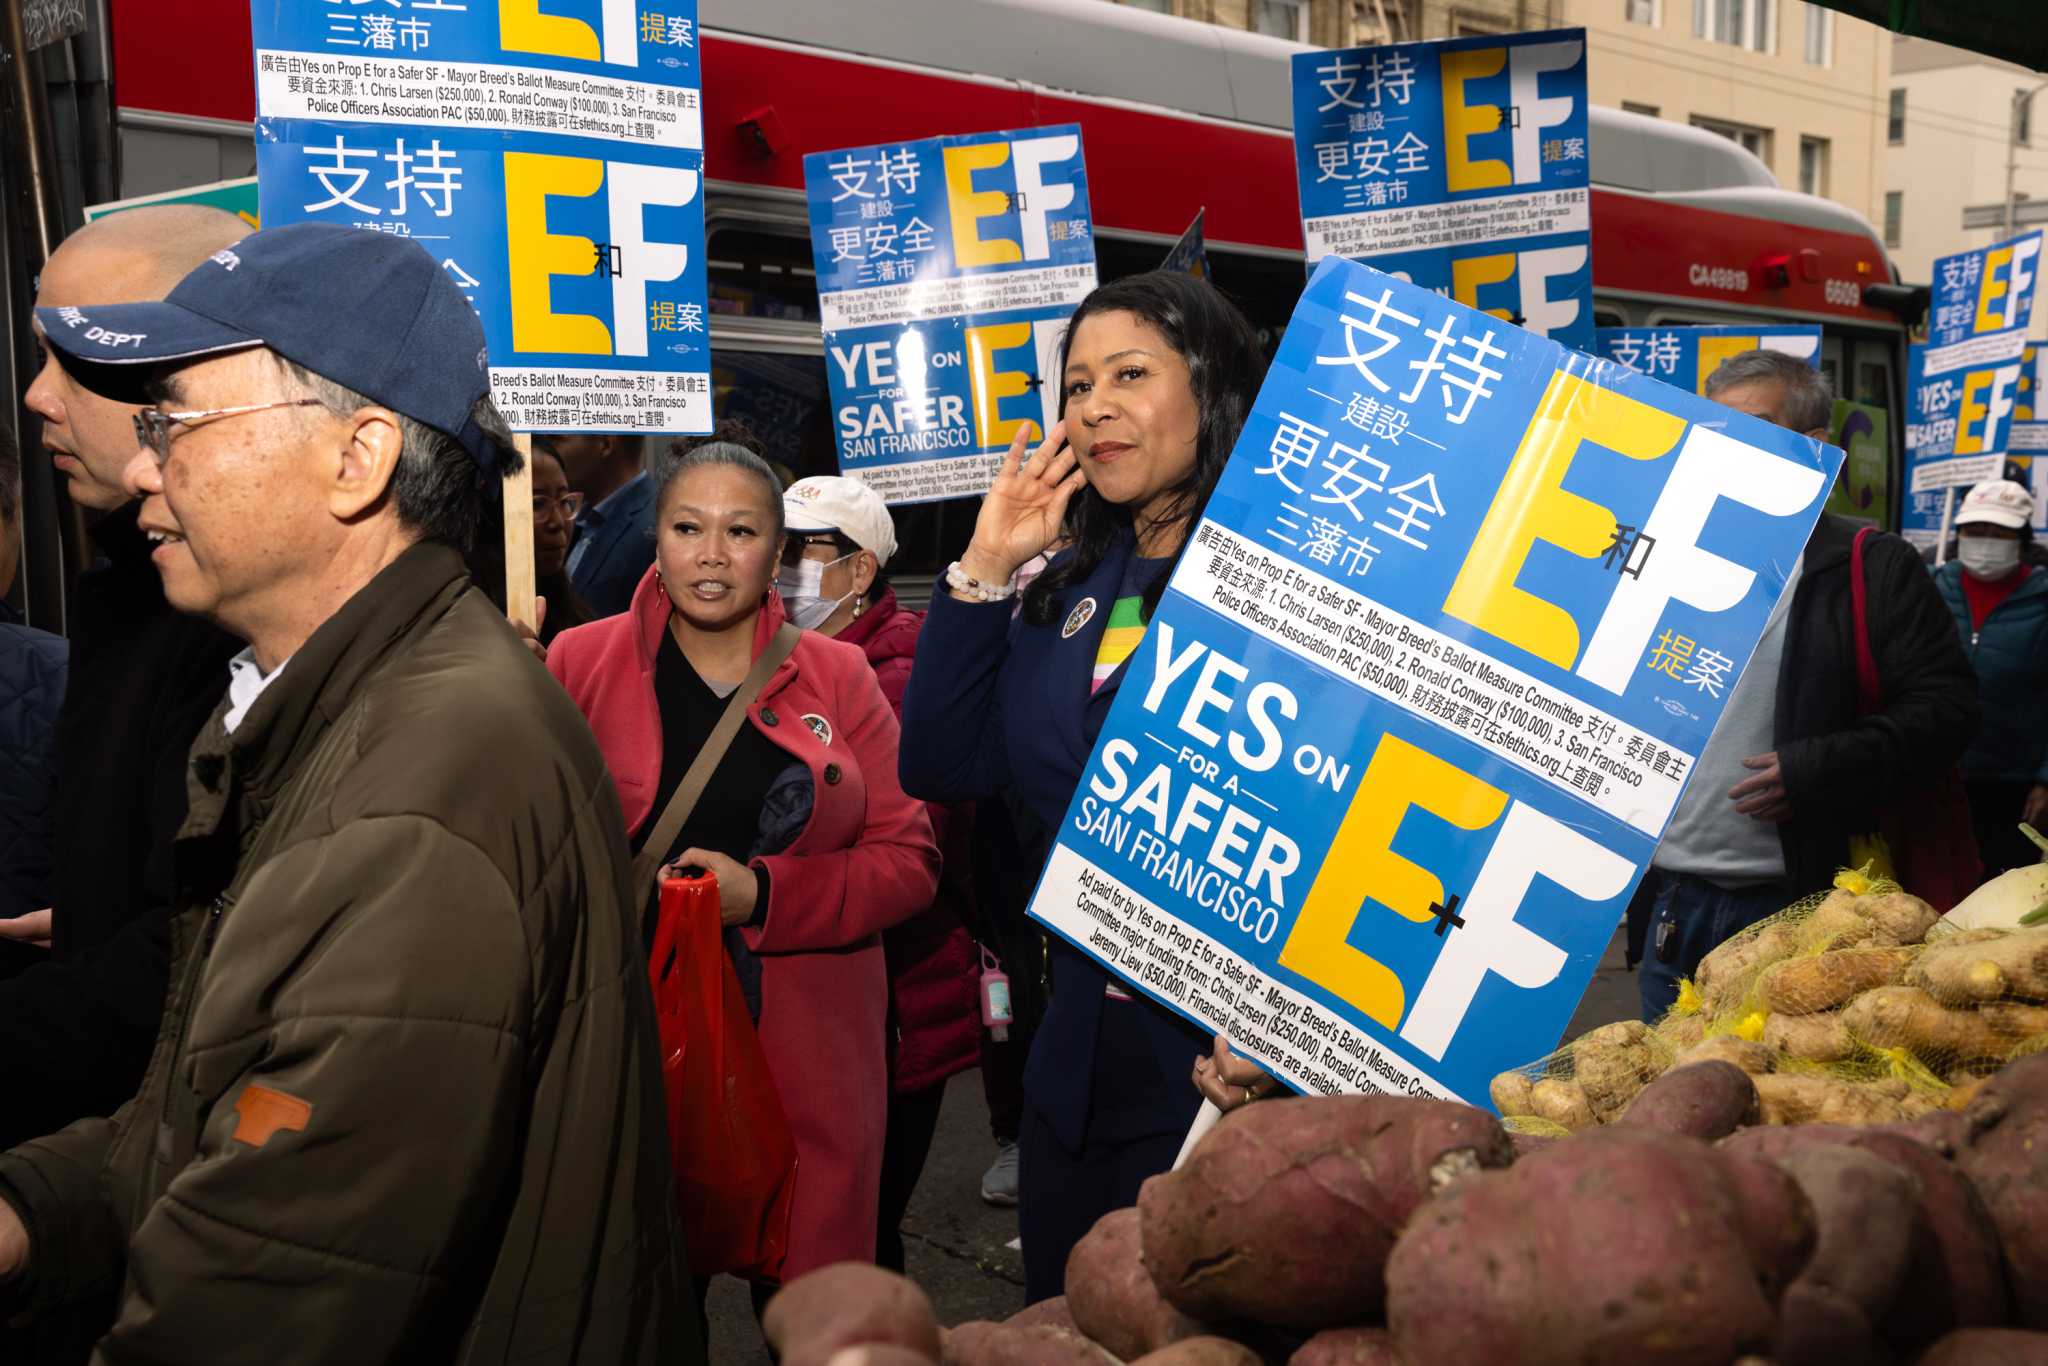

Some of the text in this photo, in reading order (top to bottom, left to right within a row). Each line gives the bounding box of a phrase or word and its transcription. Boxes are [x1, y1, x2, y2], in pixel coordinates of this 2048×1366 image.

[326, 13, 432, 52] 三藩市
[640, 11, 694, 49] 提案
[322, 63, 335, 74] on
[337, 60, 361, 78] Prop
[373, 63, 387, 77] for
[397, 65, 423, 80] Safer
[425, 66, 438, 80] SF
[447, 68, 477, 85] Mayor
[479, 70, 515, 85] Breed's
[517, 72, 543, 88] Ballot
[544, 75, 580, 92] Measure
[581, 79, 623, 98] Committee
[370, 82, 397, 97] Chris
[399, 84, 433, 99] Larsen
[498, 89, 531, 110] Ronald
[533, 92, 568, 112] Conway
[621, 103, 636, 117] San
[638, 105, 676, 122] Francisco
[1316, 52, 1415, 113] 支持
[307, 97, 338, 112] Police
[340, 99, 379, 115] Officers
[381, 102, 439, 118] Association
[441, 105, 462, 120] PAC
[464, 106, 509, 124] ($50,000).
[1349, 111, 1385, 133] 建設
[1314, 131, 1429, 183] 更安全
[1542, 138, 1584, 163] 提案
[303, 135, 463, 217] 支持
[828, 148, 921, 203] 支持
[1344, 179, 1408, 207] 三藩市
[859, 200, 894, 219] 建設
[1050, 219, 1089, 241] 提案
[828, 216, 936, 262] 更安全
[857, 257, 915, 284] 三藩市
[84, 326, 148, 348] DEPT
[650, 301, 704, 333] 提案
[931, 351, 962, 368] ON
[1316, 289, 1507, 424] 支持
[1609, 332, 1681, 376] 支持
[492, 372, 527, 386] Breed's
[529, 373, 555, 387] Ballot
[557, 373, 592, 387] Measure
[594, 374, 634, 389] Committee
[511, 391, 544, 405] Ronald
[545, 391, 580, 407] Conway
[632, 393, 646, 407] San
[648, 394, 686, 408] Francisco
[1921, 379, 1953, 415] YES
[839, 395, 967, 440] SAFER
[1340, 391, 1410, 445] 建設
[843, 427, 970, 459] SAN FRANCISCO
[1254, 411, 1446, 550] 更安全
[1266, 501, 1381, 576] 三藩市
[1601, 523, 1657, 580] 和
[1212, 584, 1240, 611] Police
[1240, 599, 1278, 630] Officers
[1276, 619, 1336, 660] Association
[1335, 648, 1361, 671] PAC
[1358, 660, 1408, 700] ($50,000).
[1245, 554, 1259, 568] on
[1258, 556, 1282, 583] Prop
[1282, 568, 1295, 585] E
[1292, 573, 1310, 592] for
[1308, 585, 1317, 597] a
[1316, 585, 1345, 610] Safer
[1343, 598, 1361, 616] SF
[1364, 608, 1399, 637] Mayor
[1396, 624, 1440, 658] Breed's
[1440, 646, 1477, 675] Ballot
[1475, 662, 1523, 698] Measure
[1524, 686, 1583, 728] Committee
[1647, 629, 1734, 698] 提案
[1142, 620, 1351, 793] YES ON
[1268, 588, 1277, 605] 1.
[1279, 593, 1307, 618] Chris
[1306, 607, 1342, 636] Larsen
[1340, 624, 1394, 666] ($250,000),
[1394, 651, 1406, 669] 2.
[1407, 656, 1452, 690] Ronald
[1450, 677, 1497, 715] Conway
[1494, 699, 1552, 744] ($100,000),
[1554, 729, 1564, 748] 3.
[1566, 735, 1589, 759] San
[1588, 746, 1642, 787] Francisco
[1177, 745, 1239, 795] FOR A
[1089, 738, 1301, 908] SAFER
[1075, 796, 1279, 944] SAN FRANCISCO
[1076, 891, 1121, 932] Committee
[1119, 924, 1147, 949] major
[1145, 937, 1184, 976] funding
[1183, 959, 1210, 988] from:
[1210, 976, 1234, 1005] Chris
[1233, 992, 1267, 1027] Larsen
[1265, 1014, 1320, 1061] ($250,000),
[1319, 1046, 1358, 1083] Ronald
[1078, 868, 1095, 888] Ad
[1090, 879, 1113, 900] paid
[1110, 888, 1125, 908] for
[1123, 896, 1137, 920] by
[1136, 904, 1153, 928] Yes
[1152, 920, 1167, 936] on
[1166, 924, 1192, 953] Prop
[1191, 938, 1203, 956] E
[1200, 943, 1217, 964] for
[1214, 956, 1223, 970] a
[1222, 958, 1247, 986] Safer
[1245, 974, 1262, 994] SF
[1264, 986, 1302, 1017] Mayor
[1299, 1005, 1339, 1042] Breed's
[1337, 1029, 1369, 1062] Ballot
[1365, 1048, 1408, 1089] Measure
[1089, 927, 1121, 962] Jeremy
[1119, 946, 1143, 973] Liew
[1140, 961, 1186, 1002] ($50,000).
[1187, 988, 1230, 1028] Financial
[1227, 1017, 1284, 1063] disclosures
[1283, 1055, 1301, 1074] are
